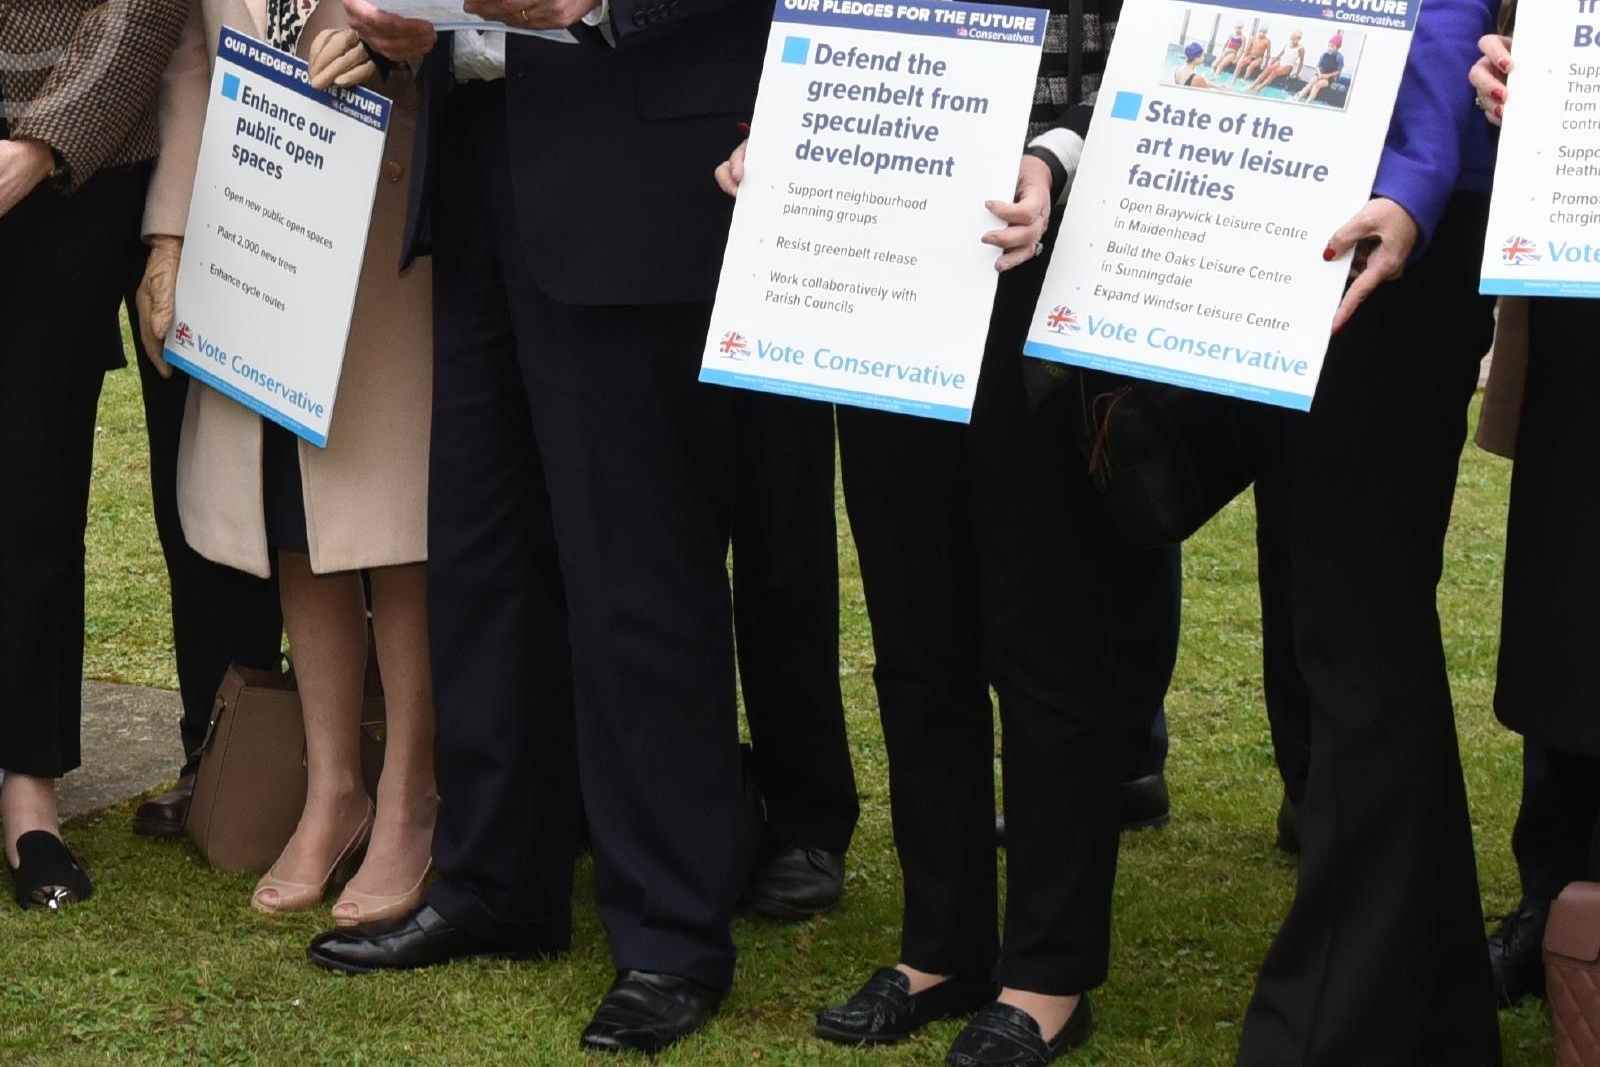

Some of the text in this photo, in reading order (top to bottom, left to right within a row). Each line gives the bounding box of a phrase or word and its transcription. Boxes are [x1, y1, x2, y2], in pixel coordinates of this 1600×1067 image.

[822, 0, 894, 18] PLEDGES
[896, 5, 931, 22] FOR
[934, 9, 967, 25] THE
[968, 12, 1036, 31] FUTURE
[1335, 9, 1406, 28] Conservatives
[814, 43, 947, 77] Defend the
[241, 84, 337, 145] Enhance our
[806, 80, 989, 115] greenbelt from
[801, 112, 939, 143] speculative
[1144, 100, 1294, 143] State of the
[231, 143, 283, 180] spaces
[235, 116, 324, 170] public open
[795, 138, 955, 178] development
[1135, 137, 1329, 183] art new leisure
[1127, 163, 1235, 202] facilities
[216, 224, 297, 275] Plant 2,000 new trees
[776, 235, 918, 266] Resist greenbelt release
[1093, 284, 1290, 332] Expand Windsor Leisure Centre
[757, 339, 966, 390] Vote Conservative
[1088, 314, 1138, 344] Vote
[1146, 327, 1308, 376] Conservative
[197, 333, 227, 366] Vote
[231, 354, 324, 419] Conservative
